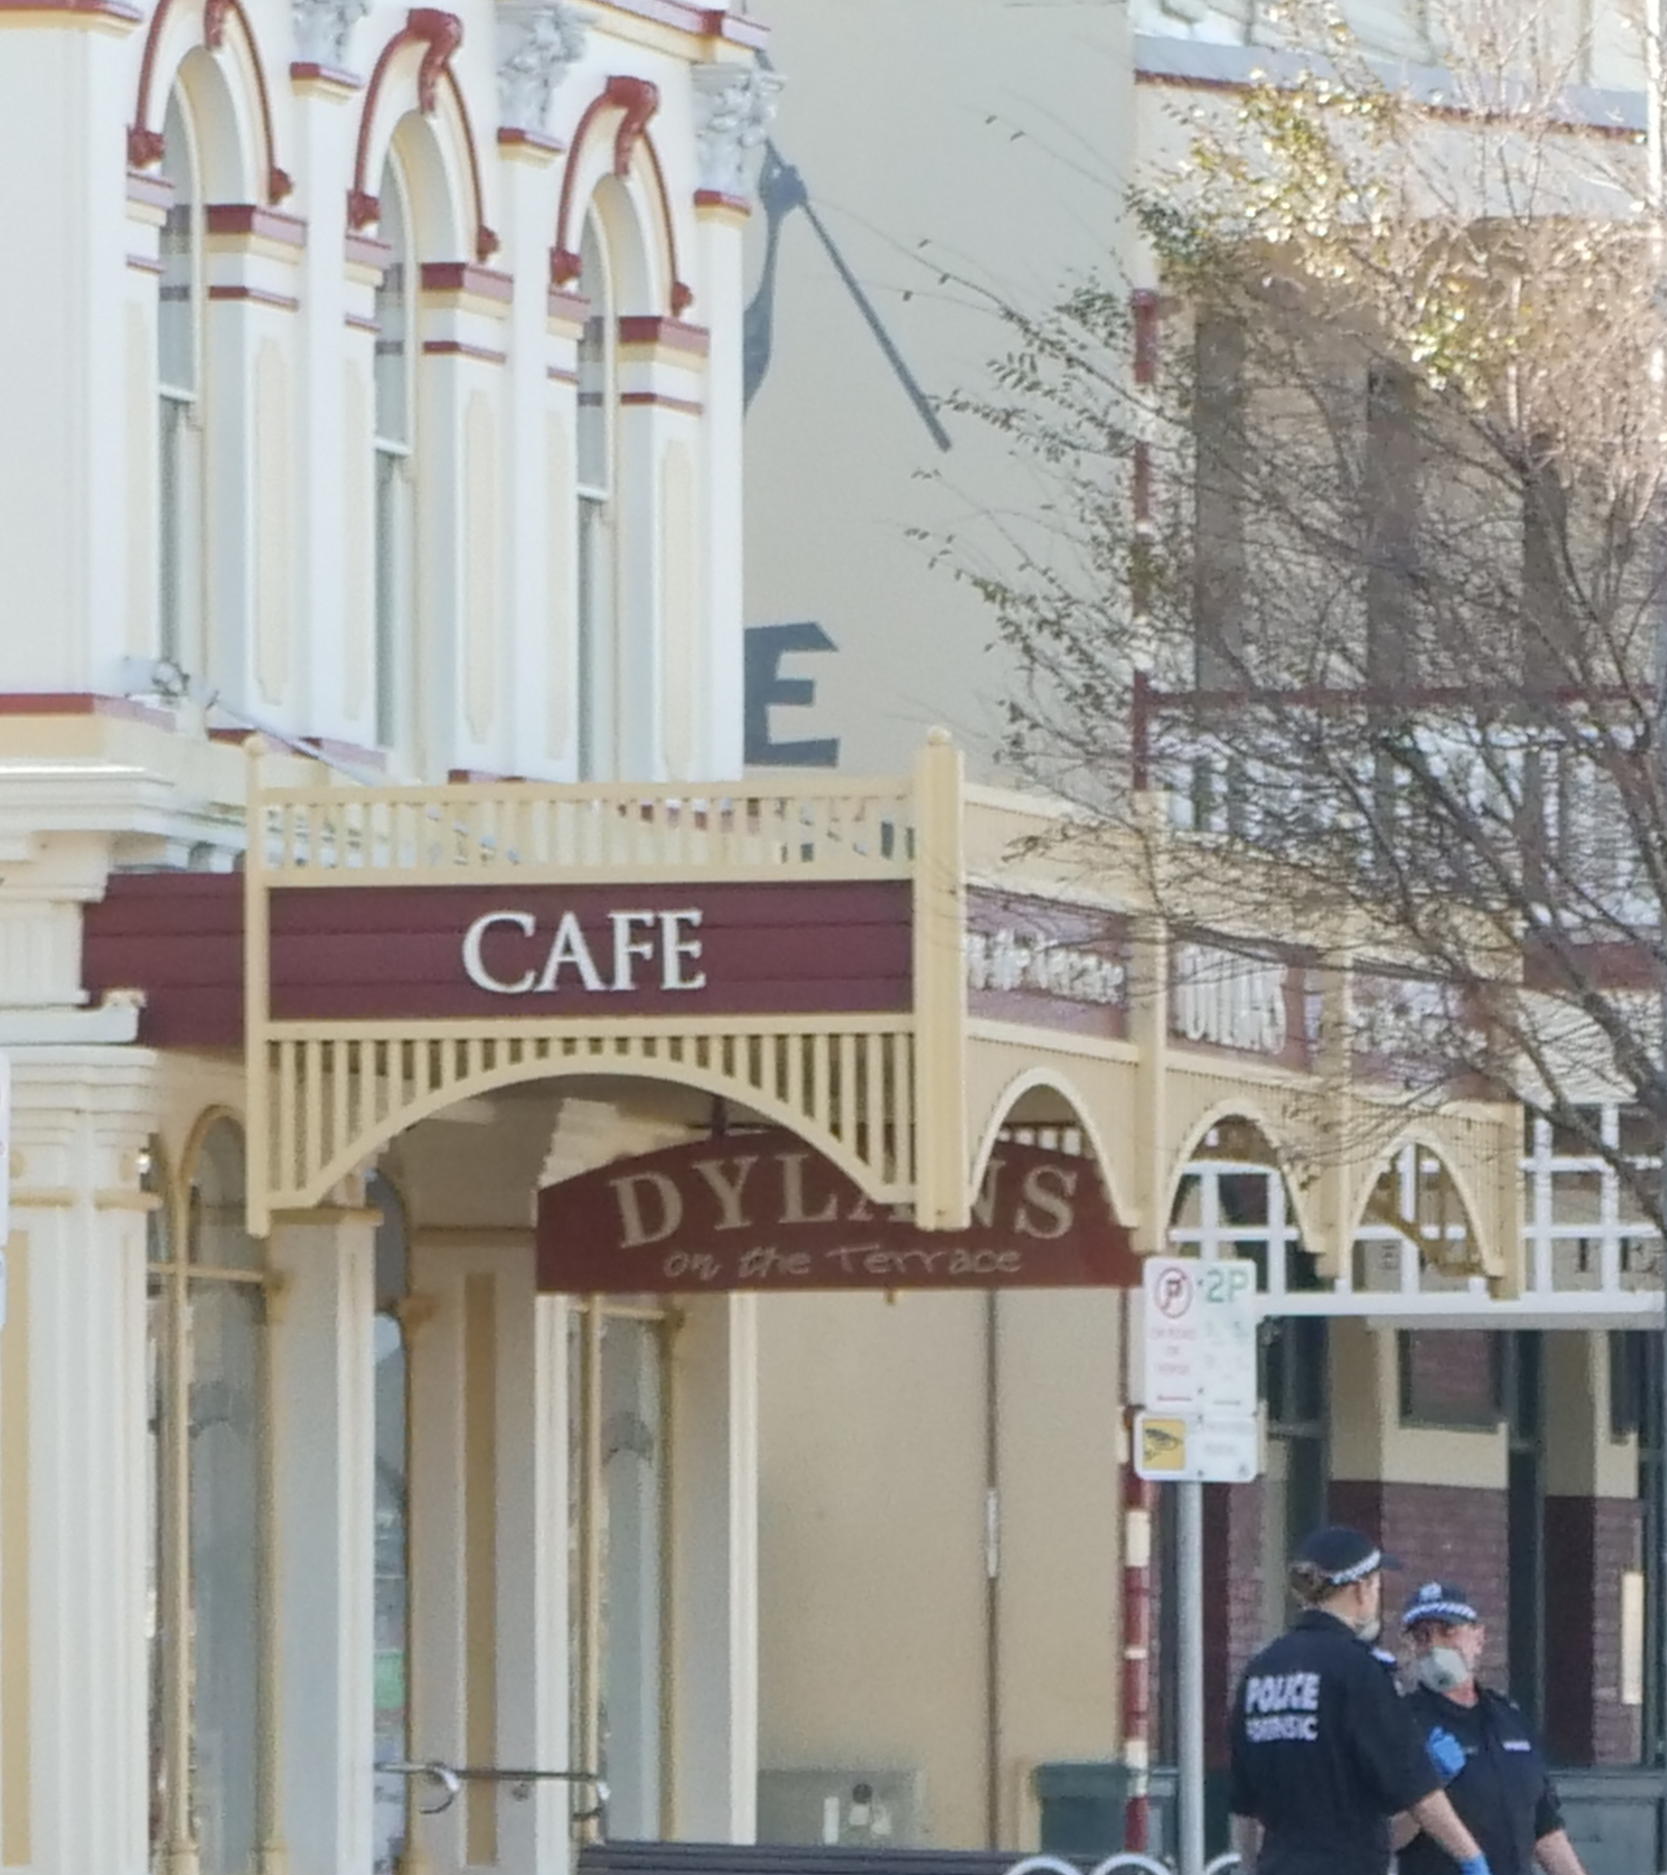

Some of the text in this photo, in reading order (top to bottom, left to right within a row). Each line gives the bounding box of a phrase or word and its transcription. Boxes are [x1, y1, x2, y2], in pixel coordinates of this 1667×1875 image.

[462, 907, 706, 994] CAFE
[608, 1153, 1079, 1248] DYLS
[664, 1242, 1022, 1279] on the Terrace
[1205, 1268, 1248, 1303] 2P
[1245, 1671, 1321, 1713] POLICE
